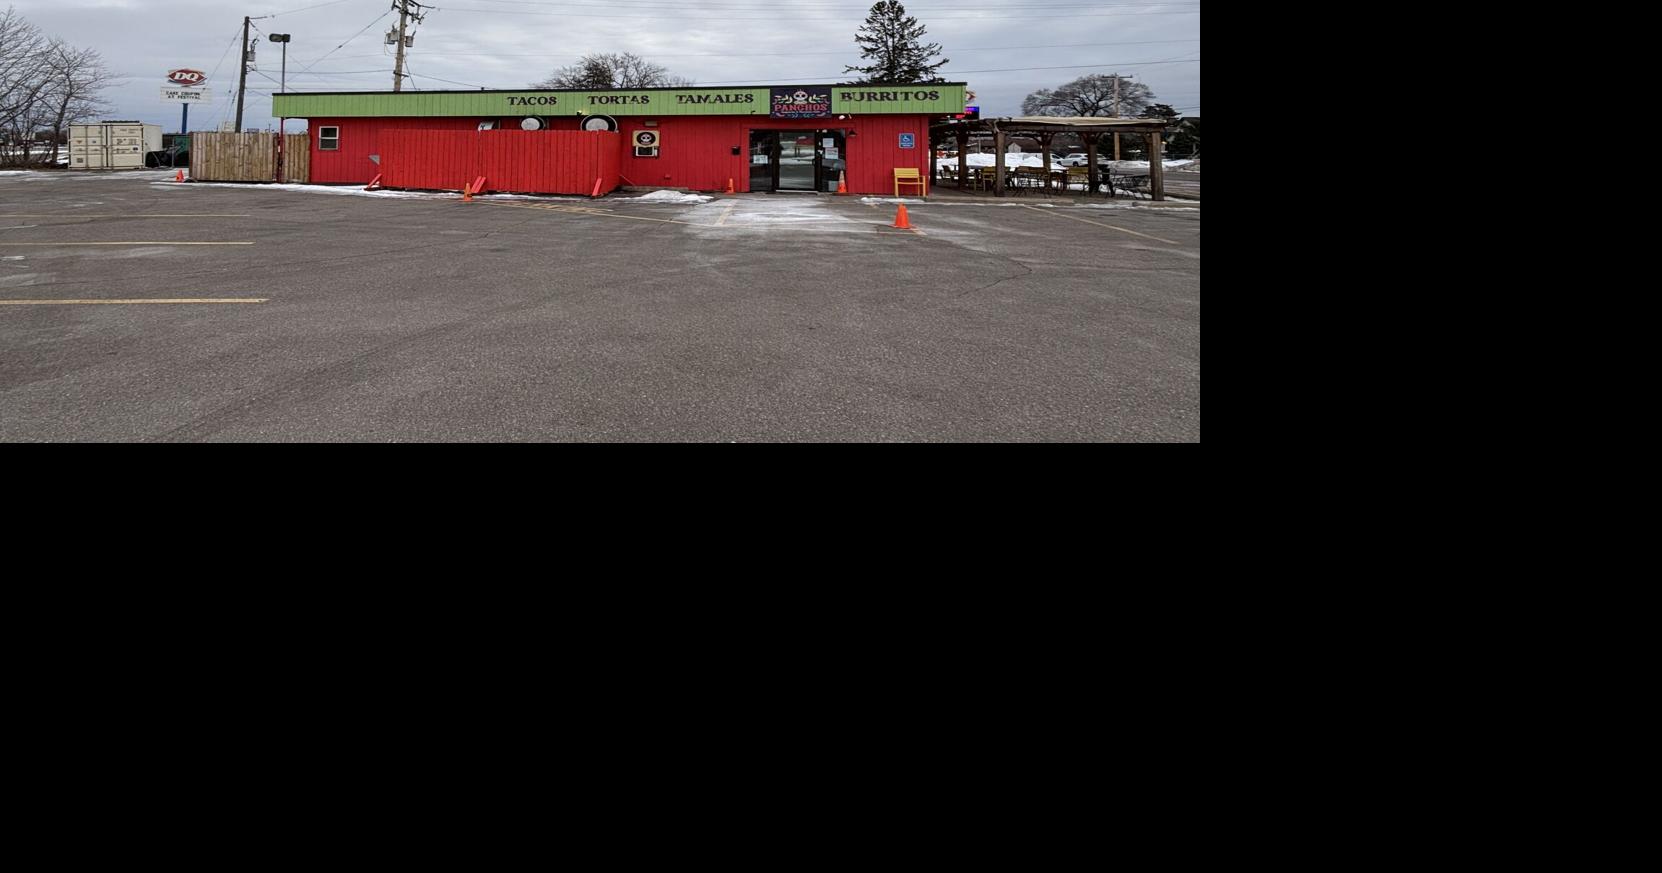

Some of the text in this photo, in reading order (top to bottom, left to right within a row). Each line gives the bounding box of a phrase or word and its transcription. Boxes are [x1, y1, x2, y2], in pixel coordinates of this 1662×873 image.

[174, 72, 199, 82] DQ
[508, 96, 557, 105] TACOS
[588, 95, 650, 105] TORTAS
[676, 94, 754, 103] TAMALES
[840, 91, 940, 101] BURRITOS
[774, 104, 828, 112] PANCHOS
